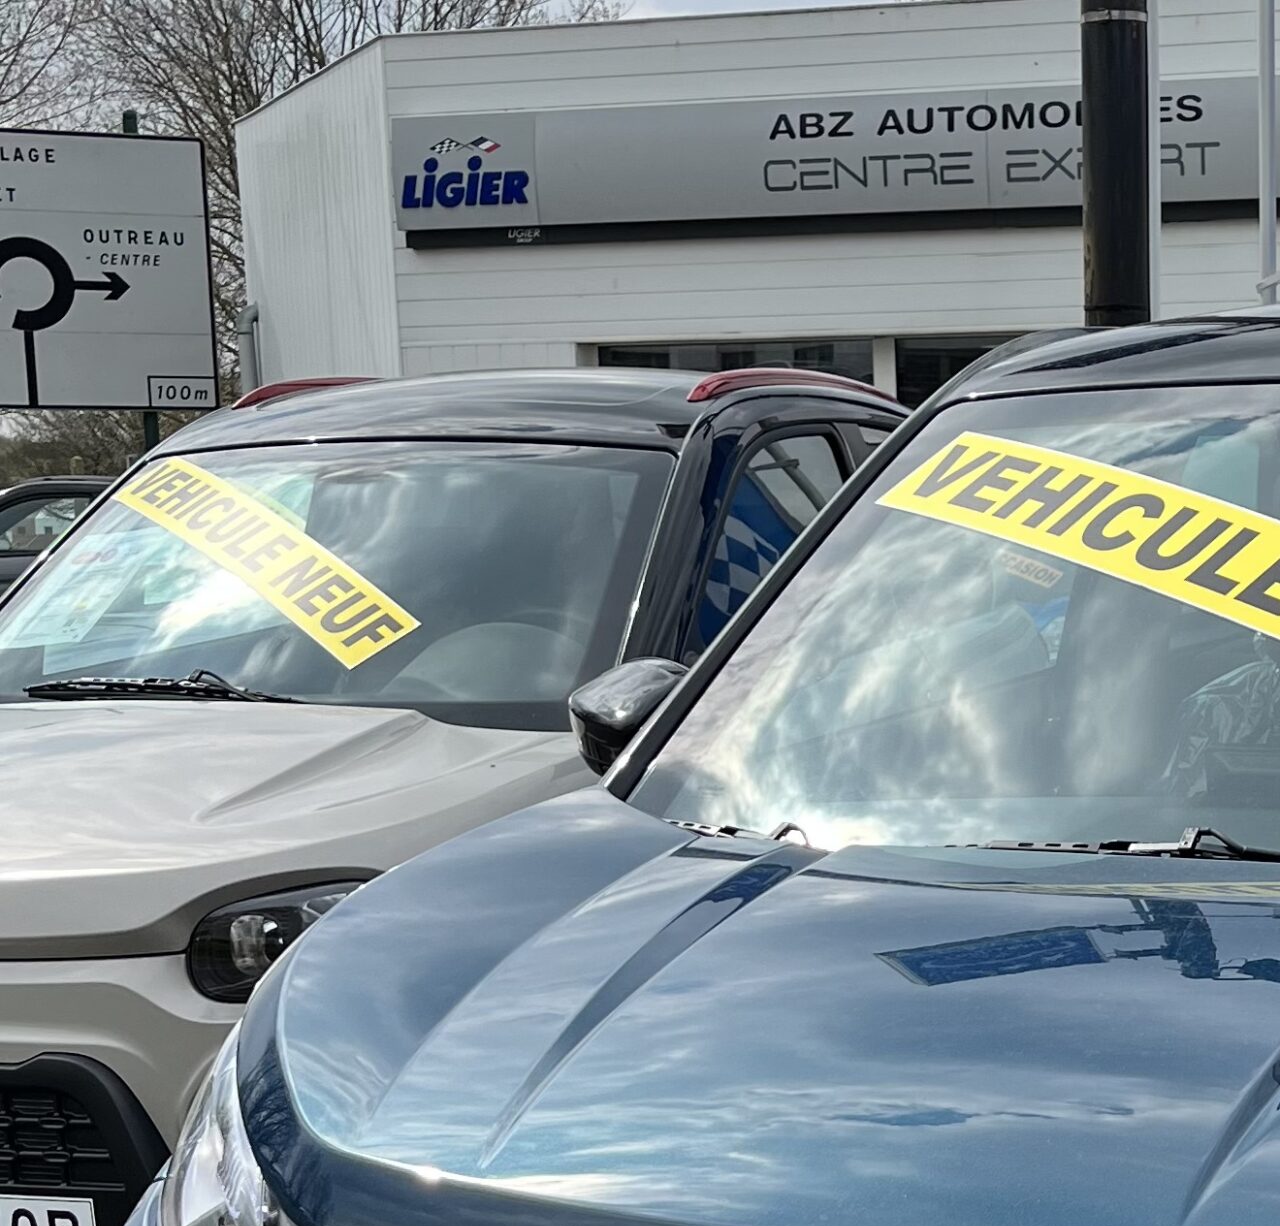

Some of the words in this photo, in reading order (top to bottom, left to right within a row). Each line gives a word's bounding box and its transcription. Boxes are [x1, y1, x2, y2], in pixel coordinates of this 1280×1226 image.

[769, 111, 854, 141] ABZ
[876, 94, 1204, 136] AUTOMOES
[763, 152, 974, 192] CENTRE
[1006, 141, 1221, 183] EXRT
[83, 229, 185, 246] OUTREAU
[100, 253, 161, 267] CENTRE
[130, 463, 299, 573] VEHICULE
[270, 556, 404, 648] NEUF
